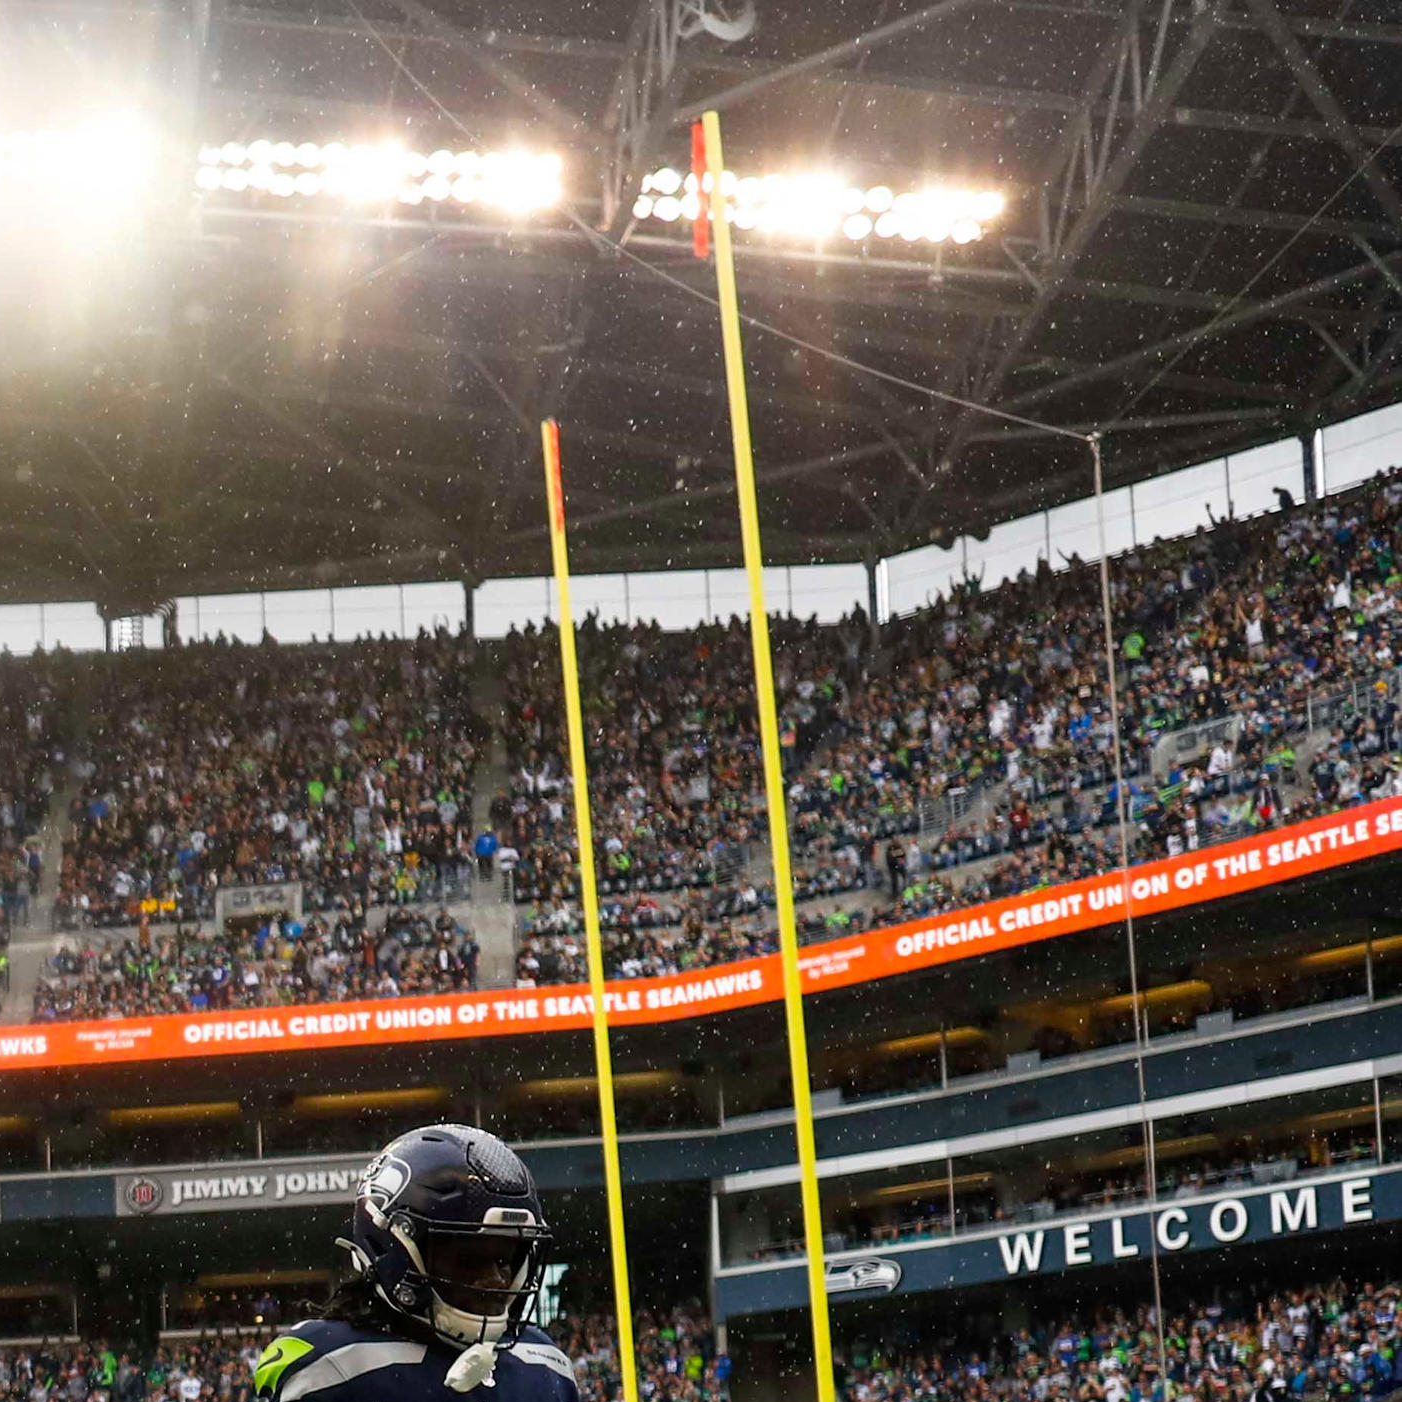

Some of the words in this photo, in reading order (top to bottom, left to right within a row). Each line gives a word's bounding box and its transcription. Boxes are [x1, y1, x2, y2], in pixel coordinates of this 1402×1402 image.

[896, 916, 996, 958] OFFICIAL
[999, 893, 1084, 932] CREDIT
[1088, 874, 1169, 911] UNON
[1175, 863, 1208, 891] OF
[1213, 850, 1262, 880] THE
[1267, 819, 1370, 868] SEATTLE
[183, 1018, 284, 1043] OFFICIAL
[288, 1011, 371, 1036] CREDIT
[376, 1004, 452, 1030] UNION
[457, 1001, 489, 1024] OF
[493, 999, 539, 1021] THE
[544, 988, 641, 1018] SEATTLE
[644, 968, 762, 1010] SEAHAWKS
[171, 1175, 267, 1206] JIMMY
[998, 1178, 1374, 1276] WELCOME
